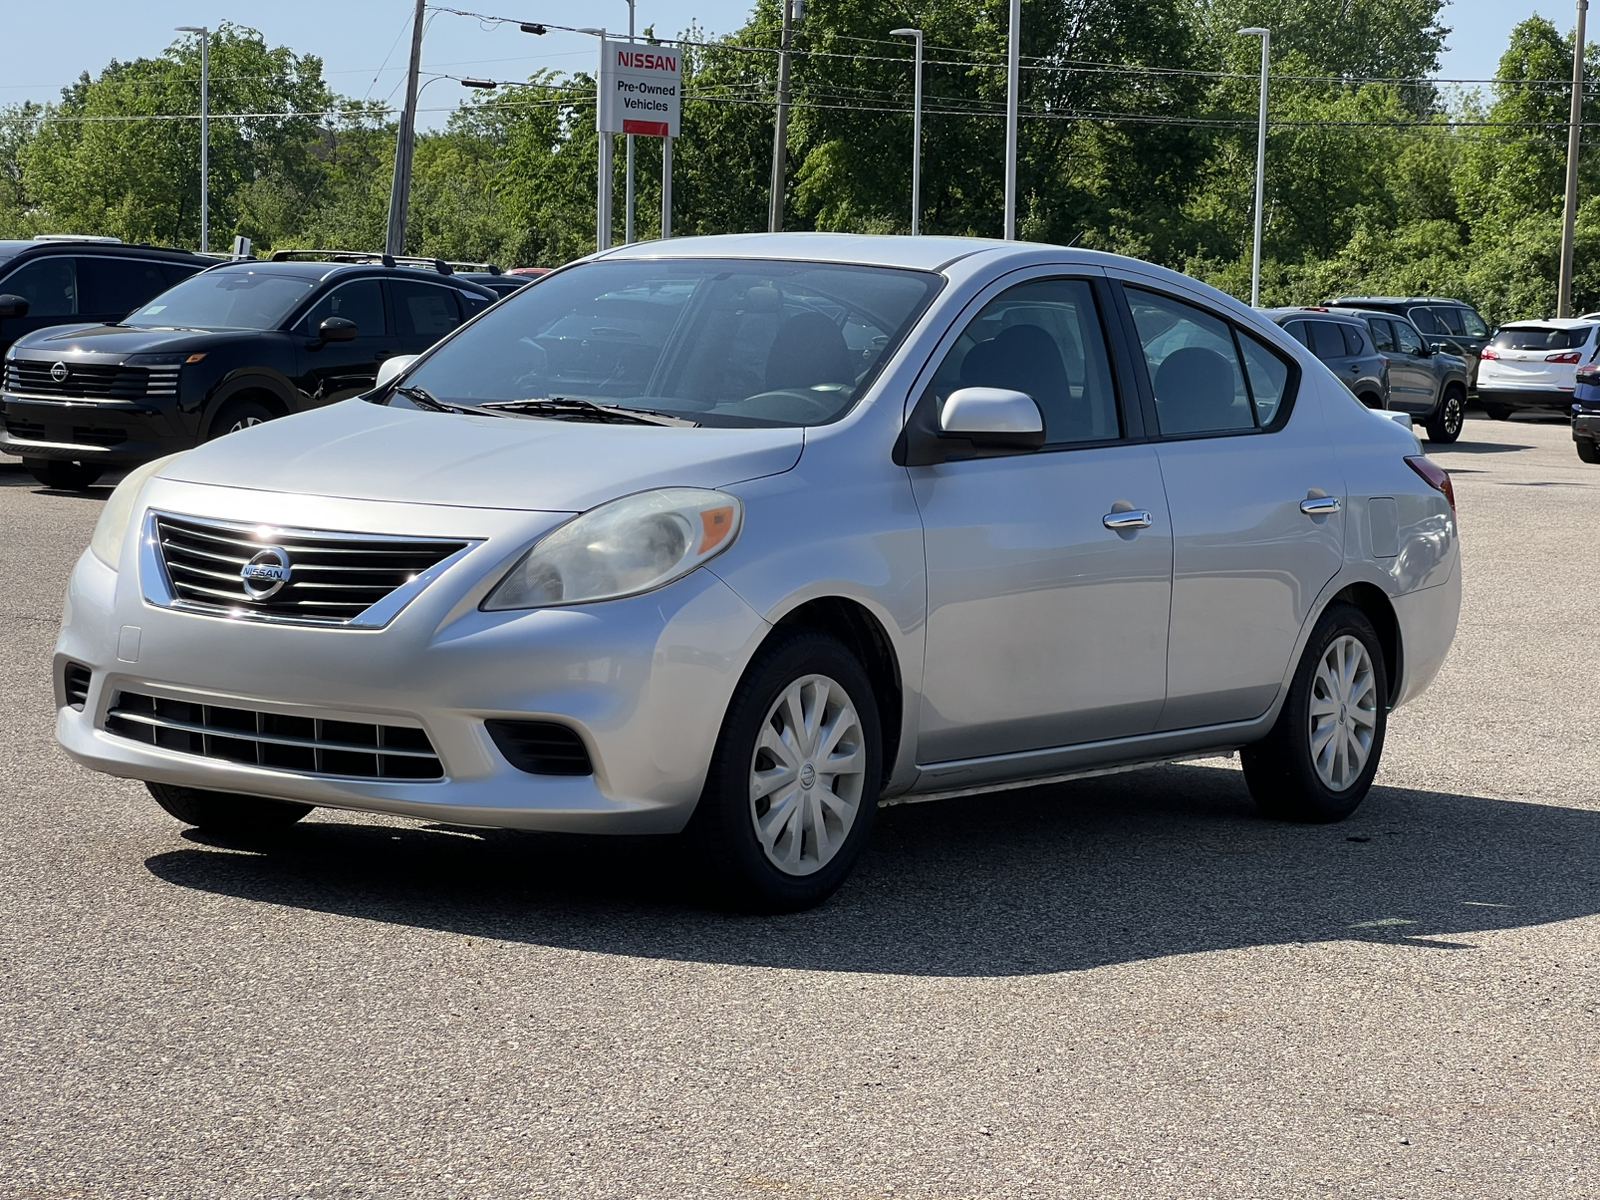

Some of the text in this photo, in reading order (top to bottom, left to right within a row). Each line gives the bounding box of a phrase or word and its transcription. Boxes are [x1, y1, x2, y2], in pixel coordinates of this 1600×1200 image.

[618, 51, 676, 72] NISSAN
[617, 80, 676, 96] Pre-Owned
[623, 97, 669, 112] Vehicles
[242, 567, 284, 578] NISSAN
